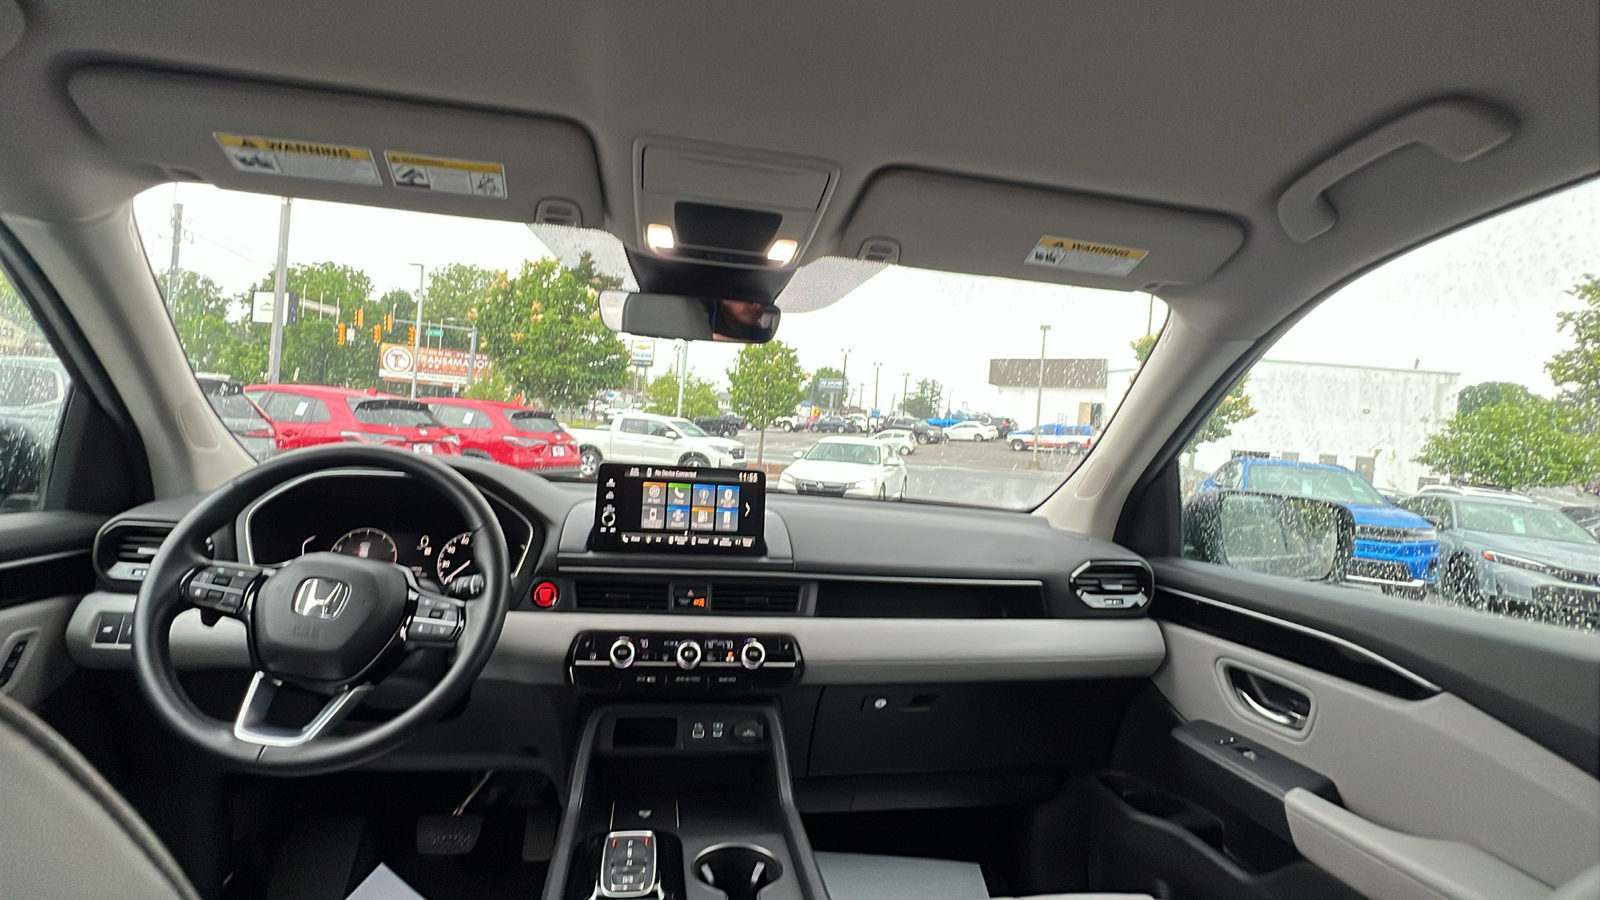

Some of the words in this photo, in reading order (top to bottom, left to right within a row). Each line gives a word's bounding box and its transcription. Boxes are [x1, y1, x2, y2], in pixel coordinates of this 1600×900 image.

[270, 141, 351, 159] WARNING
[1072, 242, 1130, 257] WARNING
[417, 354, 494, 370] TRANS4MAION
[739, 472, 758, 483] 11:55
